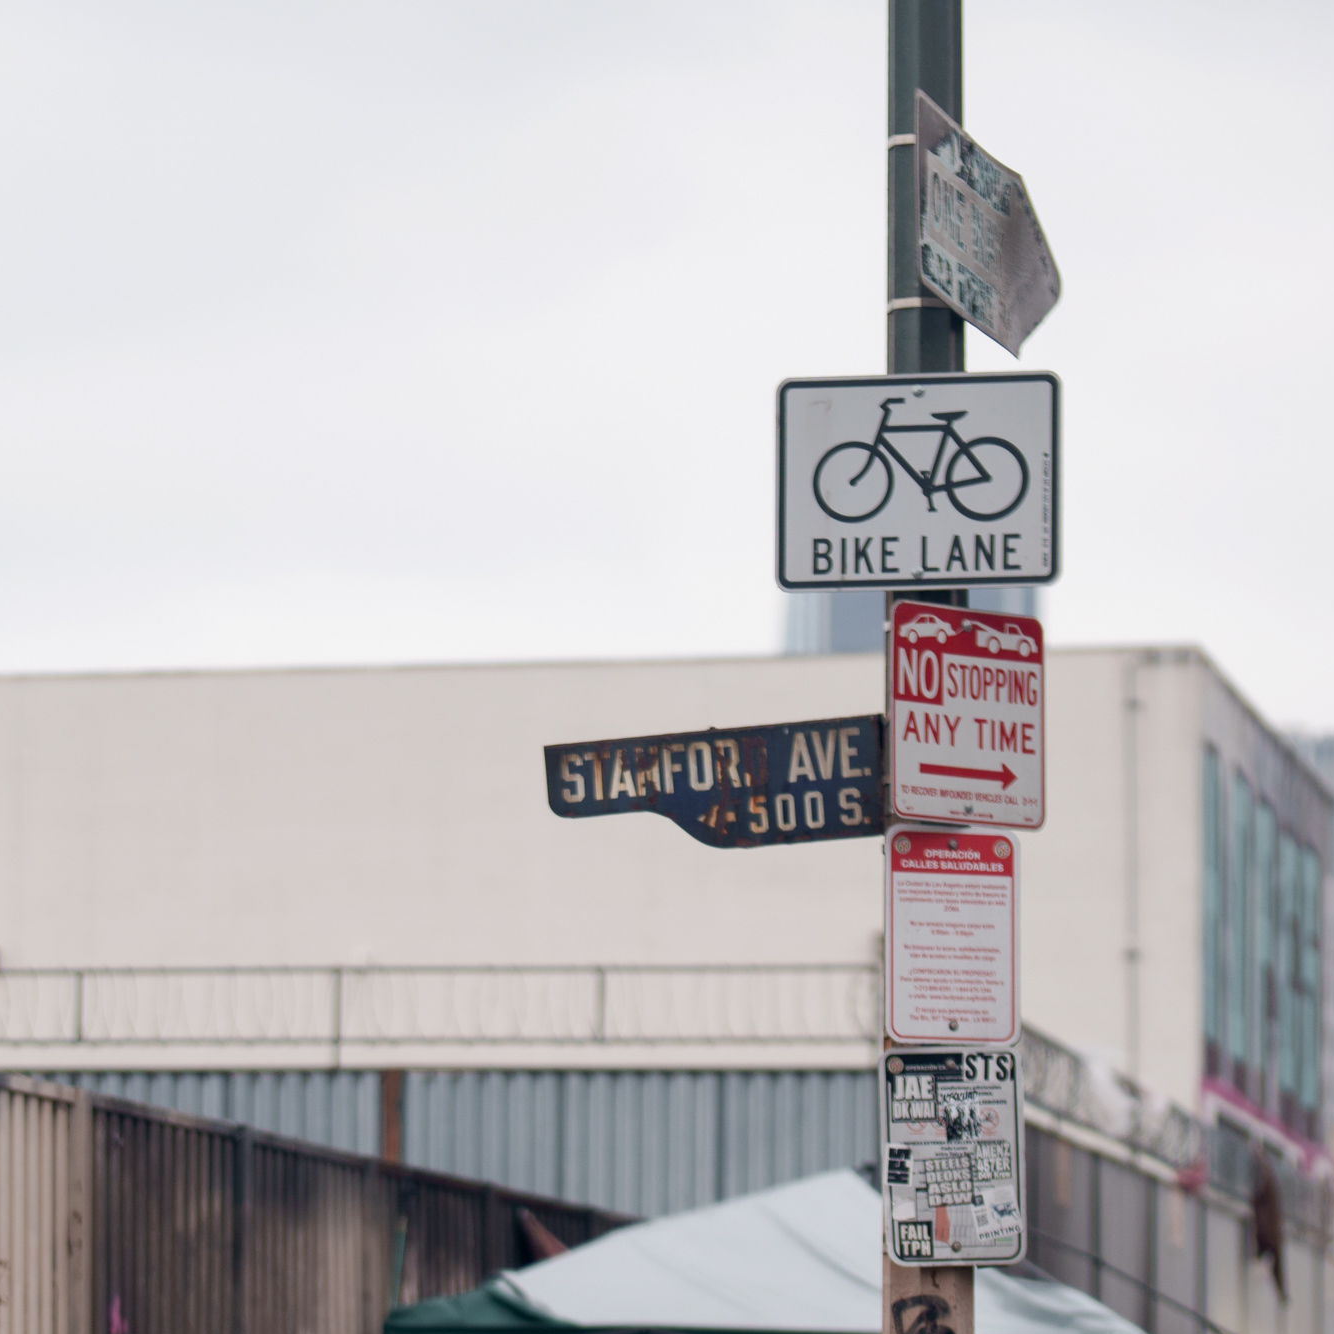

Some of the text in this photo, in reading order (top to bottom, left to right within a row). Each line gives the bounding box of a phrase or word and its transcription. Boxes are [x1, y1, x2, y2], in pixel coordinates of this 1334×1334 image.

[812, 533, 1022, 576] BIKE LANE
[898, 646, 1038, 708] NO STOPPING
[902, 709, 1036, 756] ANY TIME
[787, 727, 872, 784] AVE.
[900, 784, 909, 795] TO
[911, 785, 938, 798] RECOVER
[939, 788, 973, 801] IMPOUNDED
[974, 792, 1003, 804] VEHICLES
[1004, 795, 1019, 806] CALL
[748, 790, 827, 834] 500
[900, 859, 1004, 873] CALLES SALUDABLES
[924, 848, 981, 860] OPERACIÓN
[965, 1053, 1009, 1081] STS
[894, 1074, 934, 1100] JAE
[925, 1157, 970, 1171] STEELS
[928, 1180, 972, 1195] ASLO
[900, 1224, 931, 1241] FAIL
[979, 1225, 1021, 1241] PRINTING
